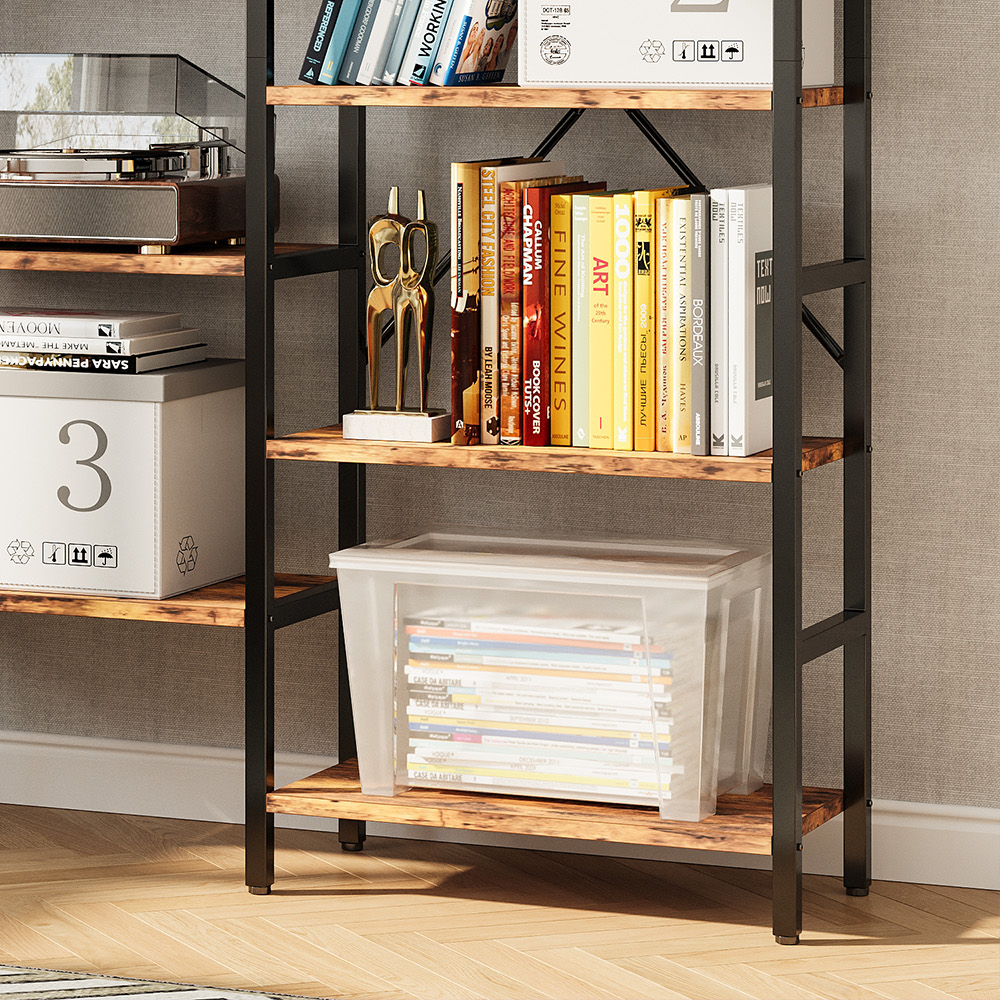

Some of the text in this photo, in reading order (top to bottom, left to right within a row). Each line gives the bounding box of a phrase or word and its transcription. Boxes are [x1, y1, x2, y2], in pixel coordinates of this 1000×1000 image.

[313, 0, 335, 52] REFERENCED
[353, 24, 366, 53] GOODMAN
[481, 169, 495, 297] STEEL CITY FASHION
[503, 239, 515, 252] AND
[523, 204, 533, 285] CHAPMAN
[534, 220, 542, 270] CALLUM
[615, 204, 630, 279] 1000
[593, 256, 608, 296] ART
[41, 341, 59, 350] THE
[63, 341, 89, 350] MAKE
[554, 231, 566, 411] FINE WINES
[693, 299, 703, 366] BORDEAUX
[93, 359, 129, 369] SARA
[485, 347, 493, 409] BY LEAH MOOSE
[532, 360, 540, 434] BOOK COVER
[57, 420, 112, 512] 3
